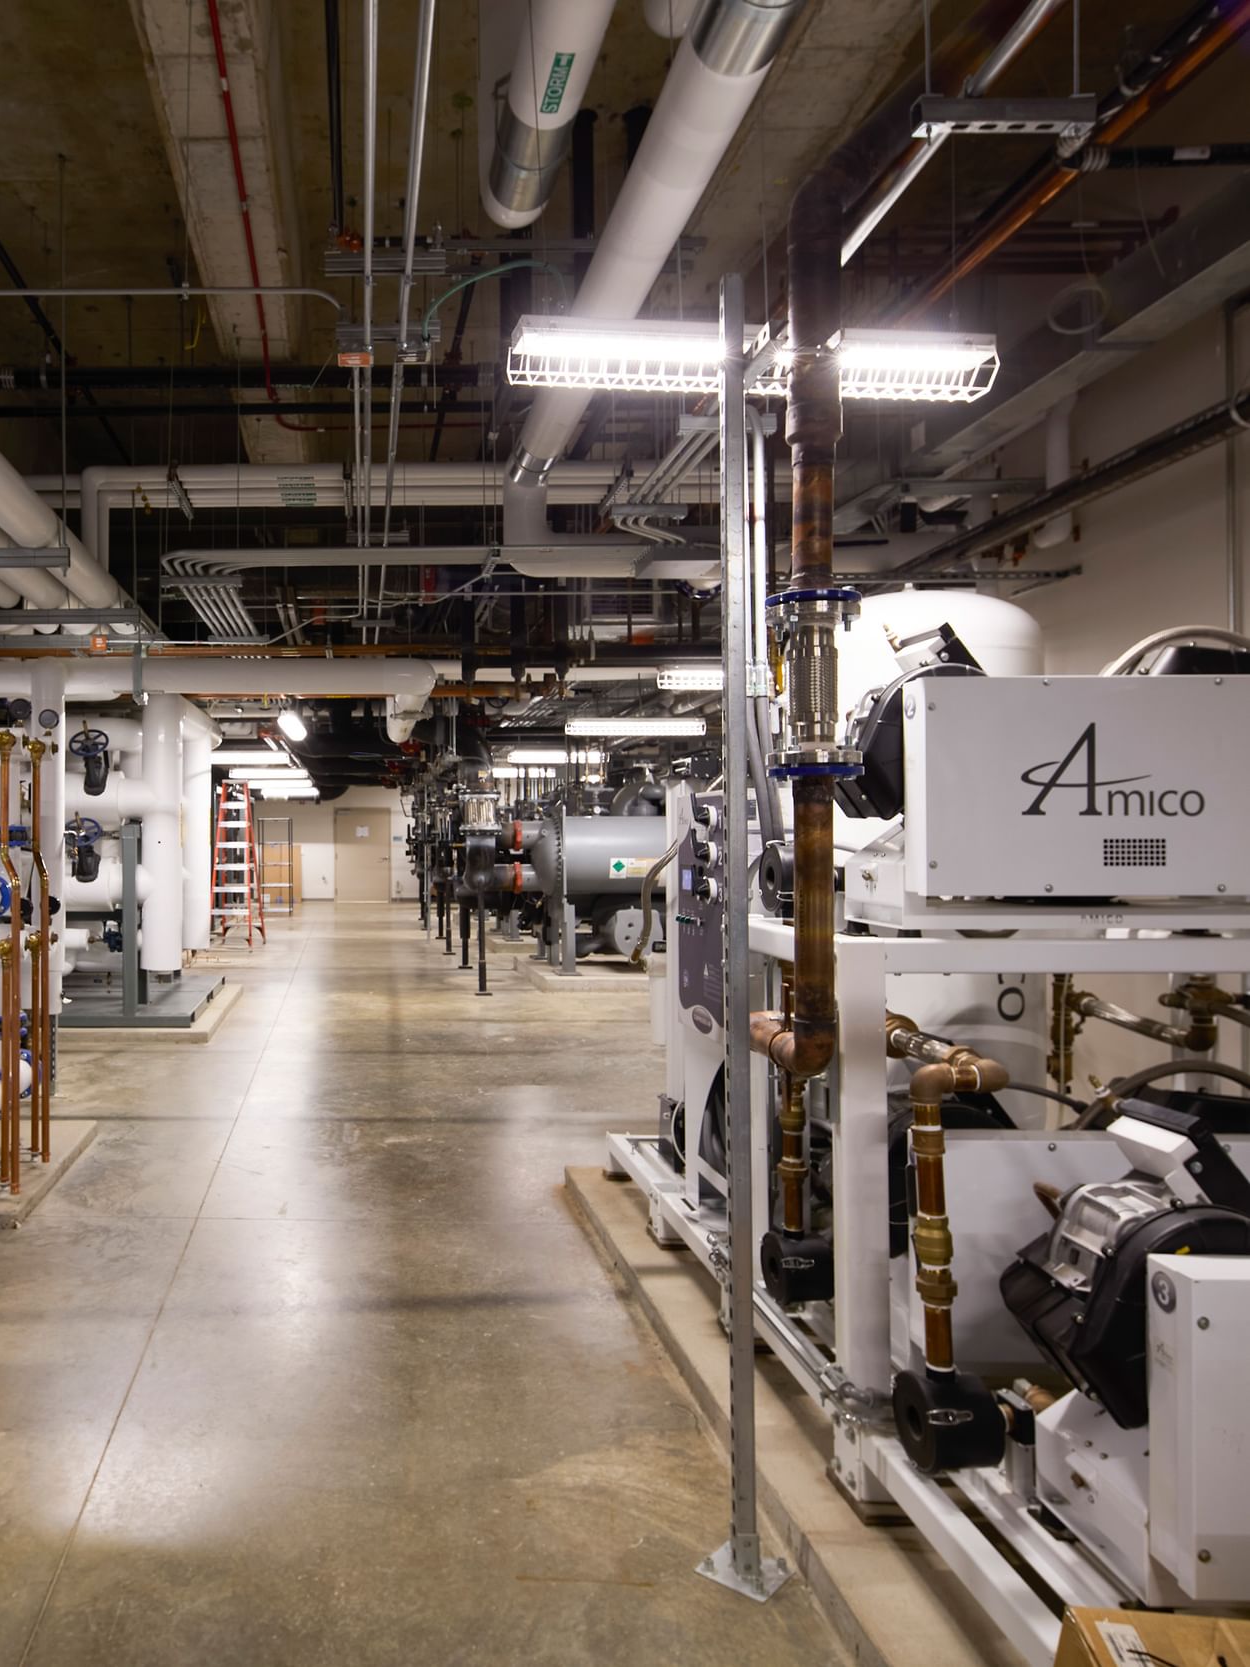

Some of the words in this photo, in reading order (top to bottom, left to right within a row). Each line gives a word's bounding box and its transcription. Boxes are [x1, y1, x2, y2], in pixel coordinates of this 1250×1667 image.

[542, 66, 569, 113] STORM
[717, 815, 722, 830] 1
[718, 850, 723, 866] 2
[718, 887, 723, 903] 3
[1157, 1279, 1170, 1306] 3
